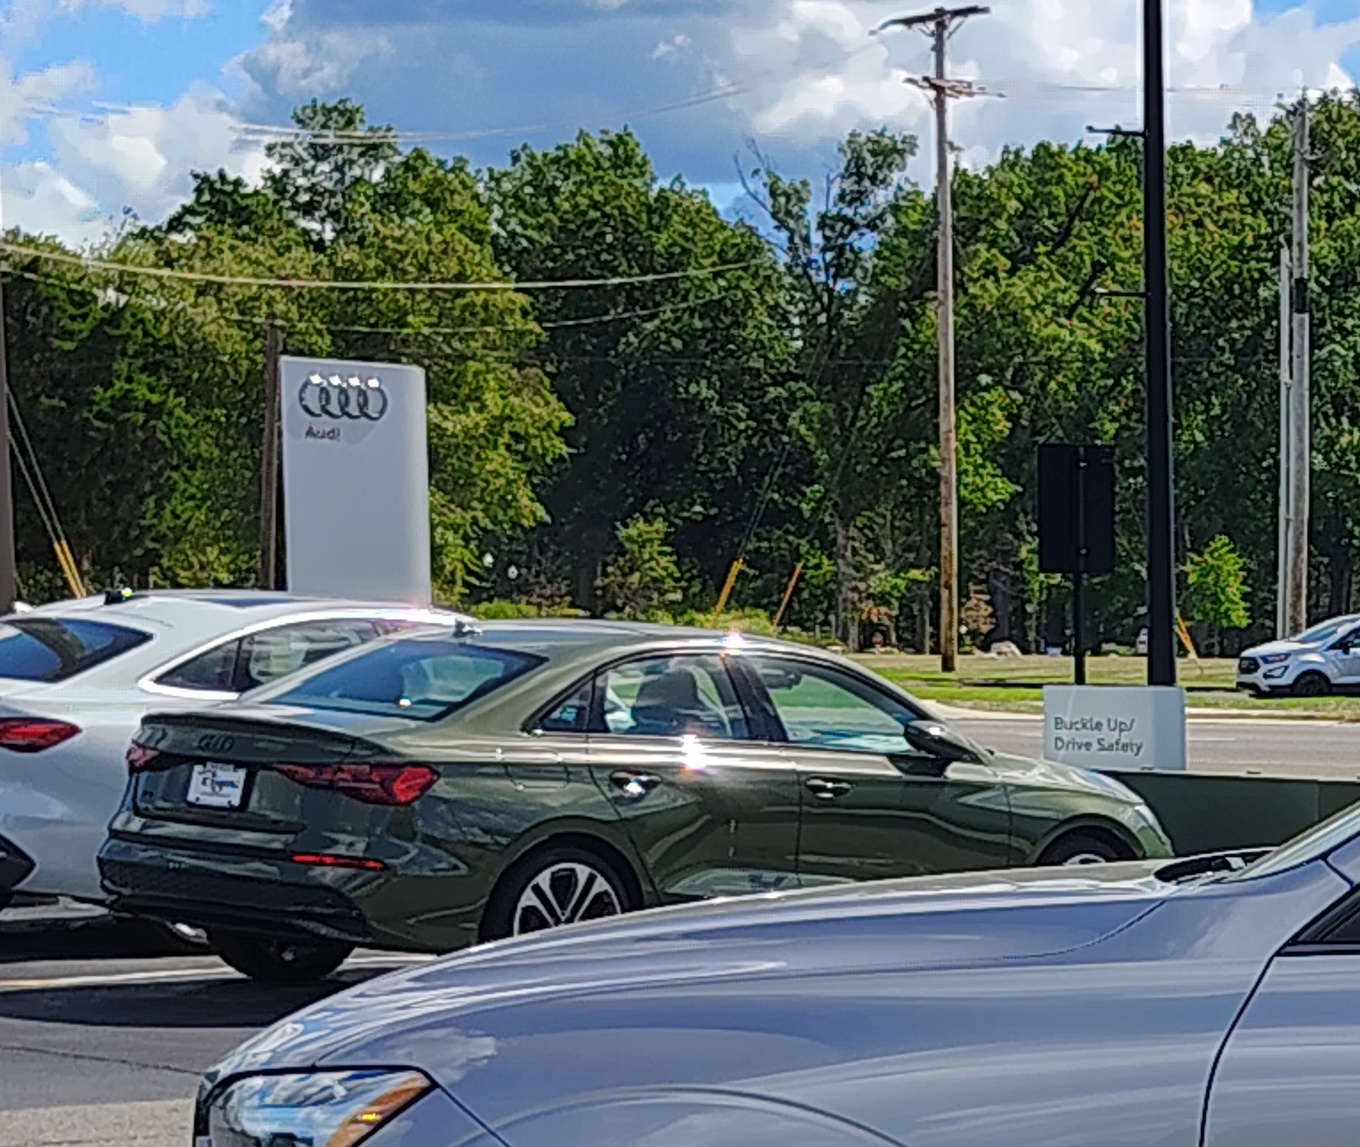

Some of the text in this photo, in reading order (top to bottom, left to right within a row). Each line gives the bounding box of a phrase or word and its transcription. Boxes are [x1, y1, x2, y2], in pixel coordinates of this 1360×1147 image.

[305, 424, 340, 442] Audi
[1054, 717, 1104, 732] Buckle
[1054, 737, 1143, 757] Drive Safety
